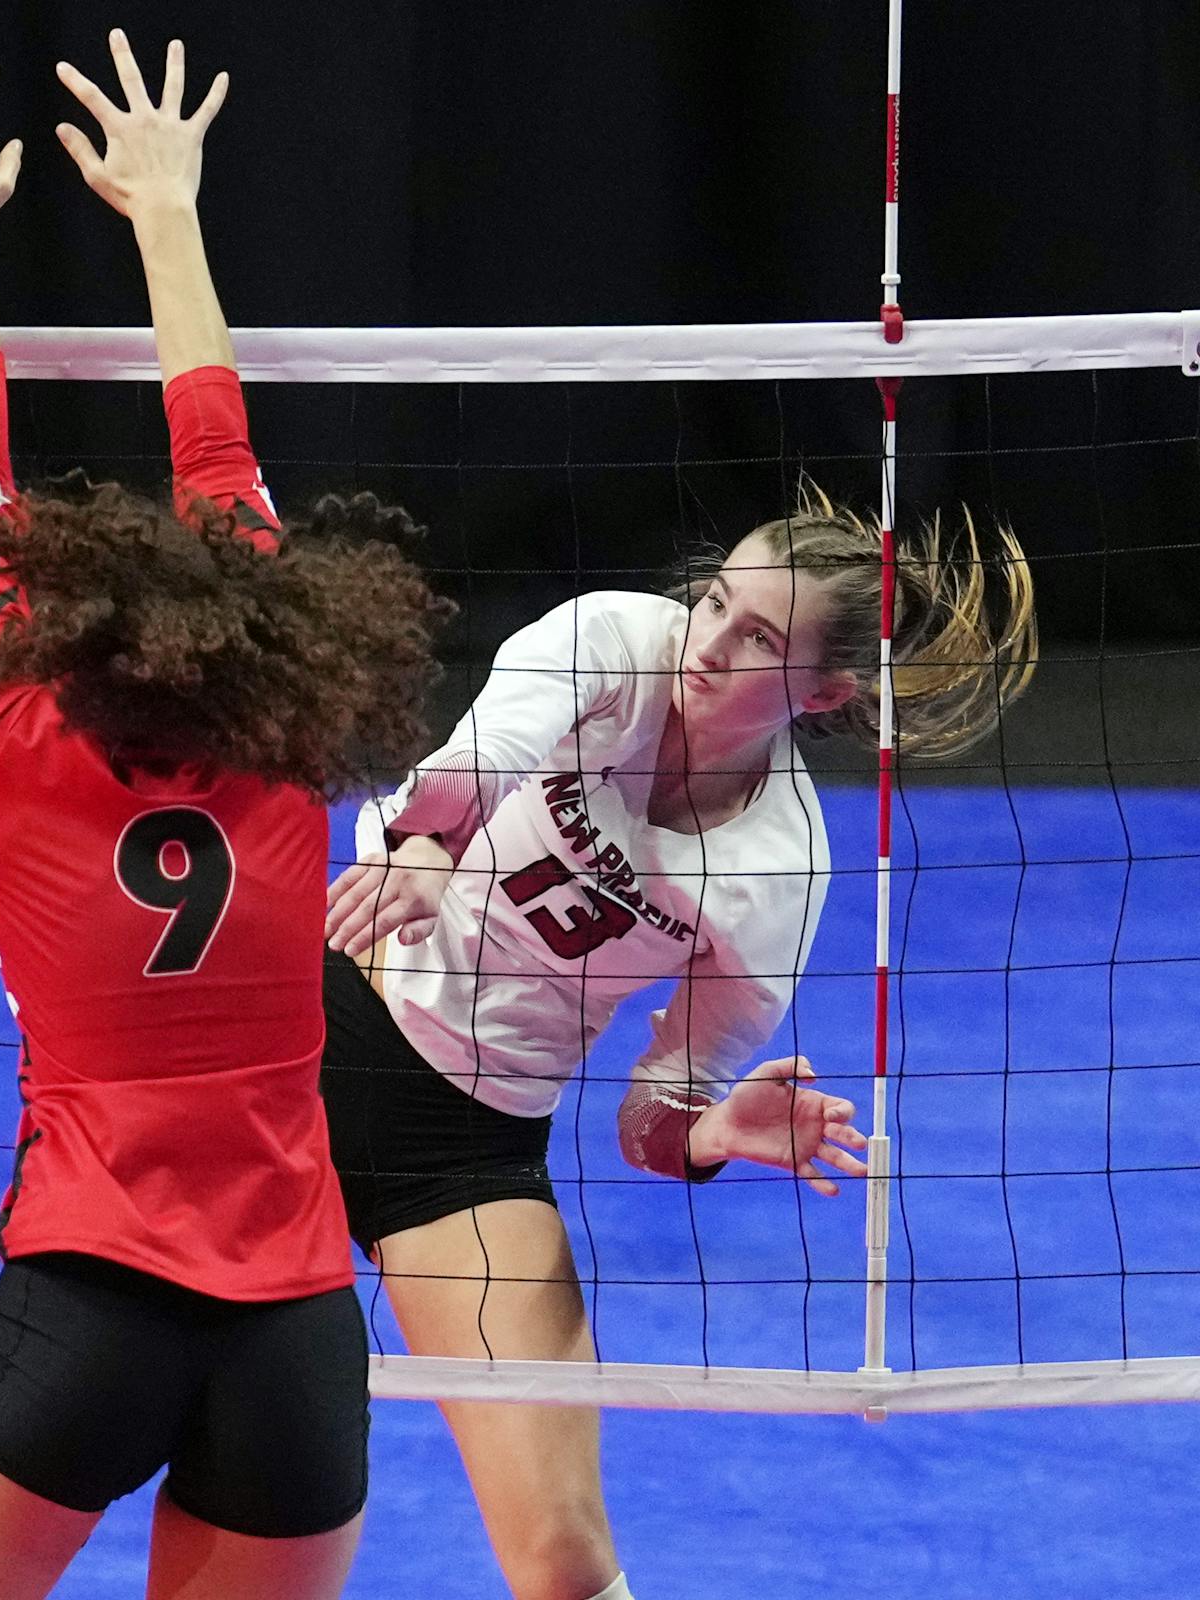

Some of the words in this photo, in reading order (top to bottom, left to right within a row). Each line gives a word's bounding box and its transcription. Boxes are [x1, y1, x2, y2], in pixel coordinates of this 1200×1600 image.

[541, 773, 601, 854] NEW
[113, 804, 236, 978] 9
[499, 853, 637, 960] 13
